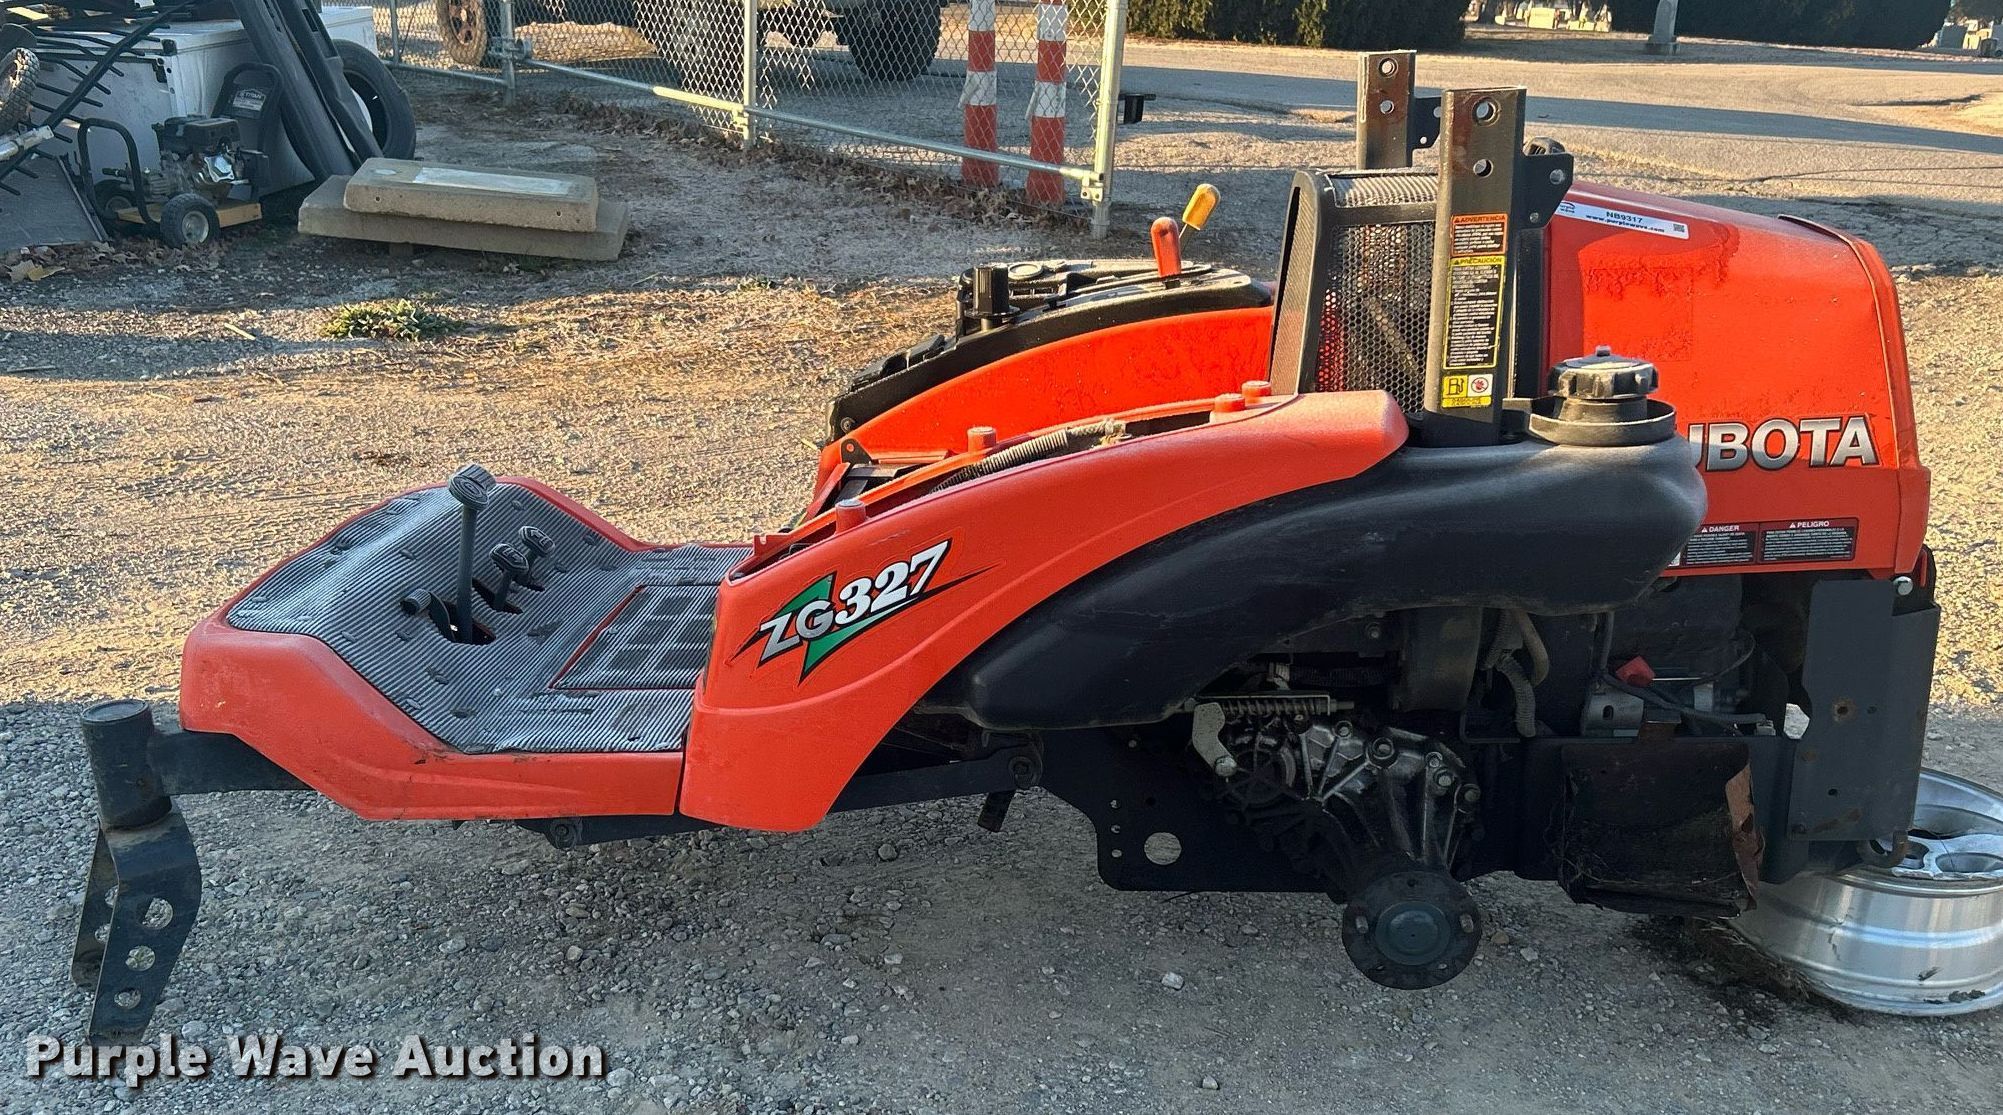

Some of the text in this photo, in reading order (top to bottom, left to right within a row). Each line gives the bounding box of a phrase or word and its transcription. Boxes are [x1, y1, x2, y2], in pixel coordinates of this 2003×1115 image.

[1461, 215, 1506, 223] ADVERTENCIA
[1606, 211, 1643, 223] NB9317
[1586, 215, 1664, 232] www.purplewave.com
[1797, 520, 1830, 528] PELIGRO
[1709, 525, 1740, 533] DANGER
